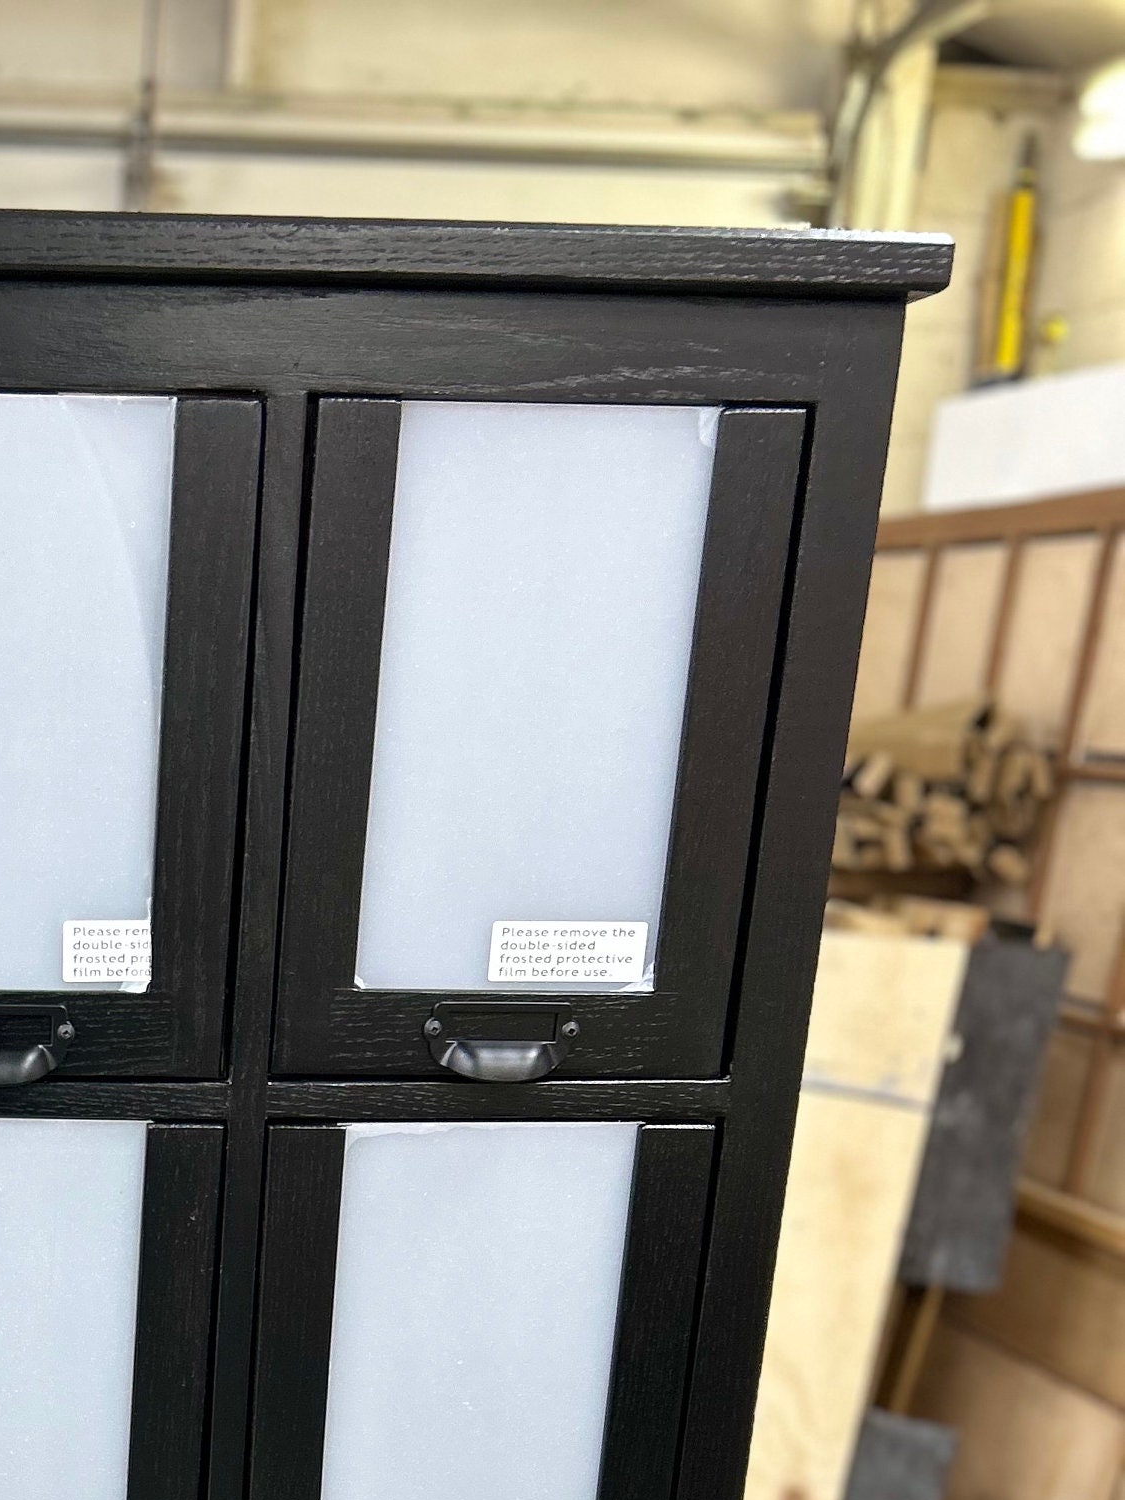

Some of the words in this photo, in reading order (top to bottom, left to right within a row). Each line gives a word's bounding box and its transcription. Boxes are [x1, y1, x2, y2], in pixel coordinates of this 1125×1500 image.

[73, 926, 121, 937] Please
[501, 926, 550, 938] Please
[553, 929, 608, 938] remove
[612, 927, 636, 938] the
[72, 952, 126, 964] frosted
[499, 953, 552, 964] frosted
[556, 954, 633, 966] protective
[72, 966, 102, 978] film
[498, 966, 527, 977] film
[531, 966, 580, 978] before
[583, 969, 612, 978] use.
